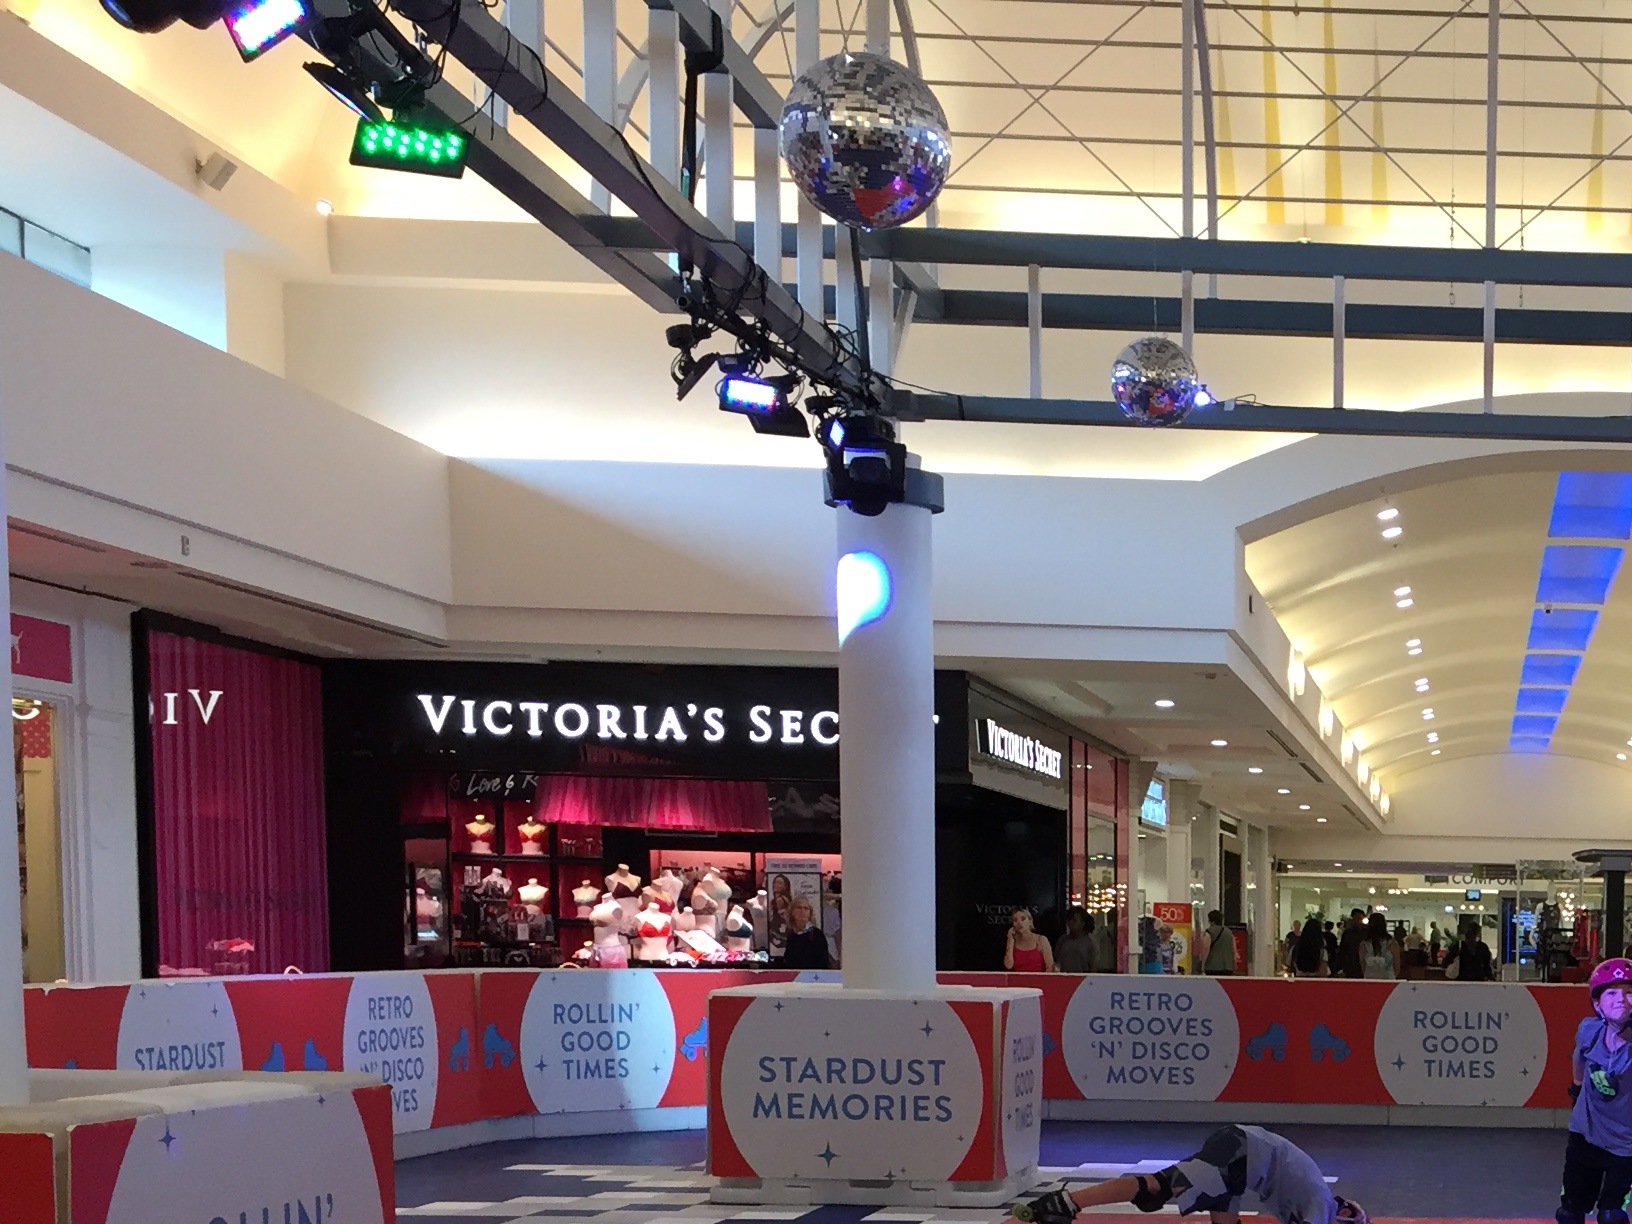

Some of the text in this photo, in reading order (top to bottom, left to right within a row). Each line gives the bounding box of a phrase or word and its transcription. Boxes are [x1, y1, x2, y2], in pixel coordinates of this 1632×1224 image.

[418, 695, 840, 745] VICTORIA'S SEC
[987, 718, 1062, 779] VICTORIA'S SECRET
[367, 995, 414, 1021] RETRO
[553, 1003, 640, 1025] ROLLIN'
[1110, 992, 1193, 1013] RETRO
[1088, 1016, 1213, 1038] GROOVES
[1414, 1009, 1510, 1031] ROLLIN'
[357, 1025, 425, 1054] GROOVES
[561, 1031, 631, 1052] GOOD
[1422, 1034, 1499, 1055] GOOD
[134, 1041, 225, 1071] STARDUST
[1090, 1042, 1210, 1062] 'N' DISCO
[382, 1056, 424, 1083] DISCO
[562, 1057, 629, 1080] TIMES
[758, 1056, 946, 1087] STARDUST
[1106, 1065, 1196, 1085] MOVES
[1424, 1059, 1496, 1079] TIMES
[392, 1088, 419, 1113] VES
[752, 1092, 953, 1123] MEMORIES
